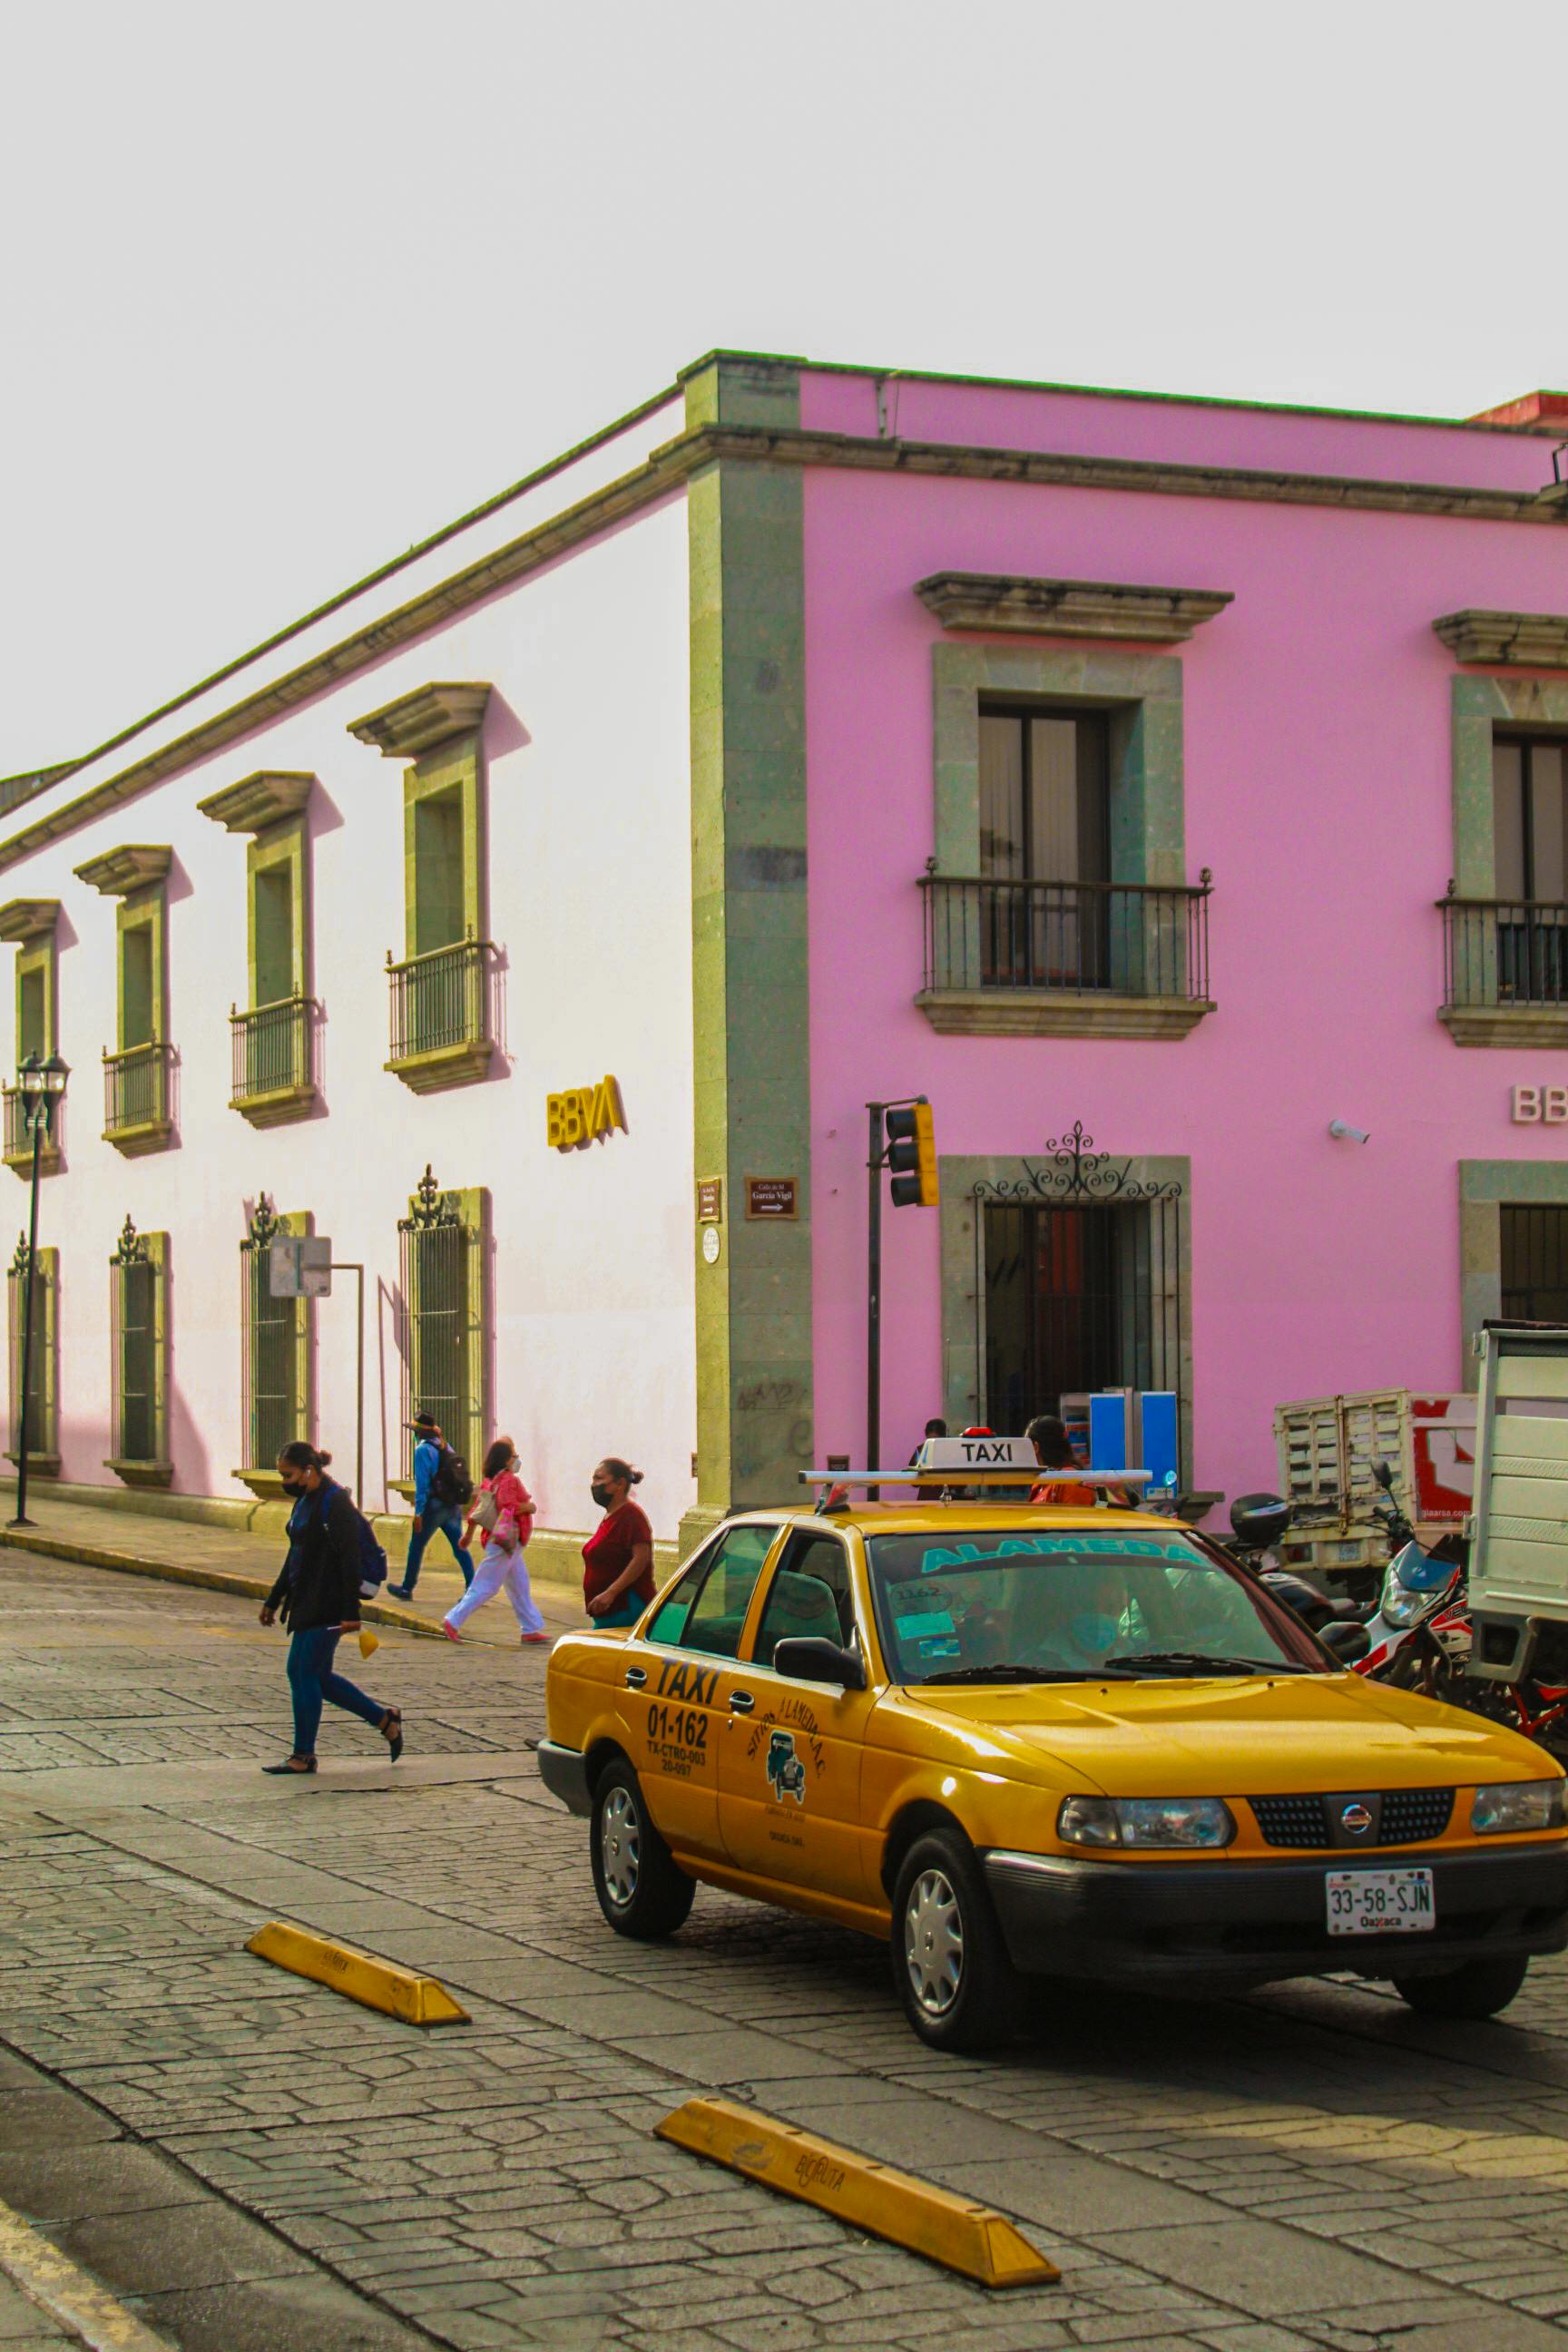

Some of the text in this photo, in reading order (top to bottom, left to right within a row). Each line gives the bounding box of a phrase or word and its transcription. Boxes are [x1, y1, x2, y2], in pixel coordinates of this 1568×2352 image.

[547, 1074, 623, 1147] BBVA
[961, 1443, 1013, 1463] TAXI
[921, 1538, 1214, 1573] ALAMEDA
[657, 1657, 724, 1704] TAXI
[648, 1703, 708, 1749] 01-162
[1331, 1886, 1431, 1915] 33-58-SJN
[1360, 1916, 1402, 1927] Oaxaca
